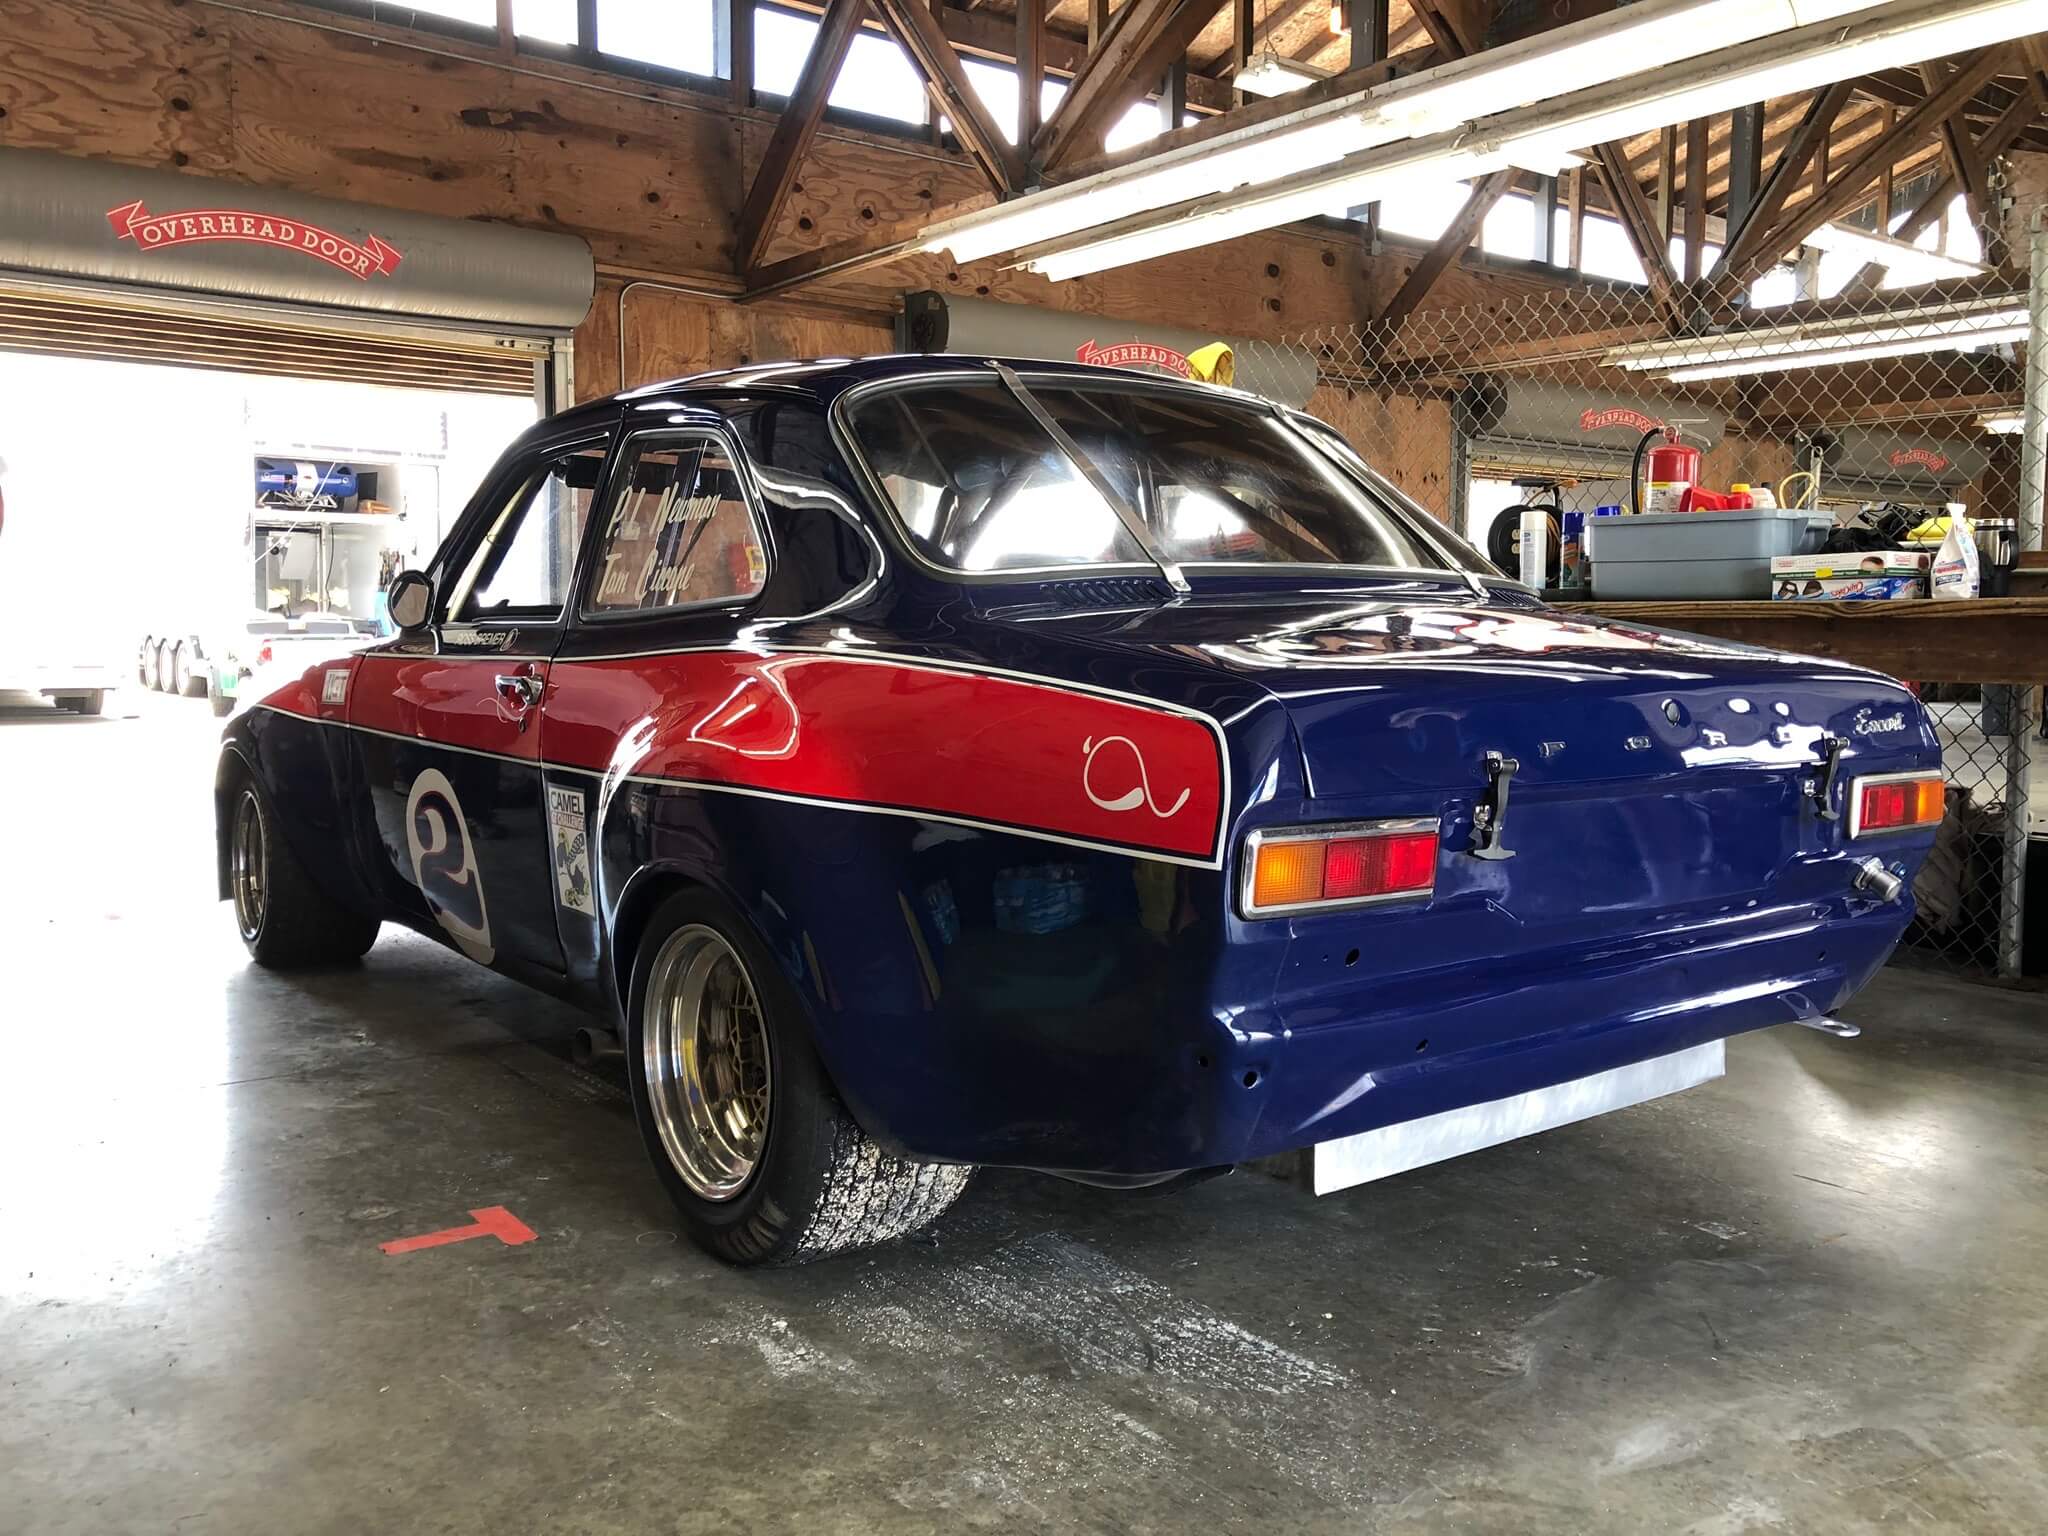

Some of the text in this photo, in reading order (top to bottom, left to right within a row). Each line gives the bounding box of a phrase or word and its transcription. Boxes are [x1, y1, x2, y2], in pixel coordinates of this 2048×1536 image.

[143, 215, 371, 274] OVERHEAD DOOR
[1090, 347, 1191, 376] OVERHEAD DOO
[551, 790, 584, 816] CAMEL
[414, 790, 484, 931] 2
